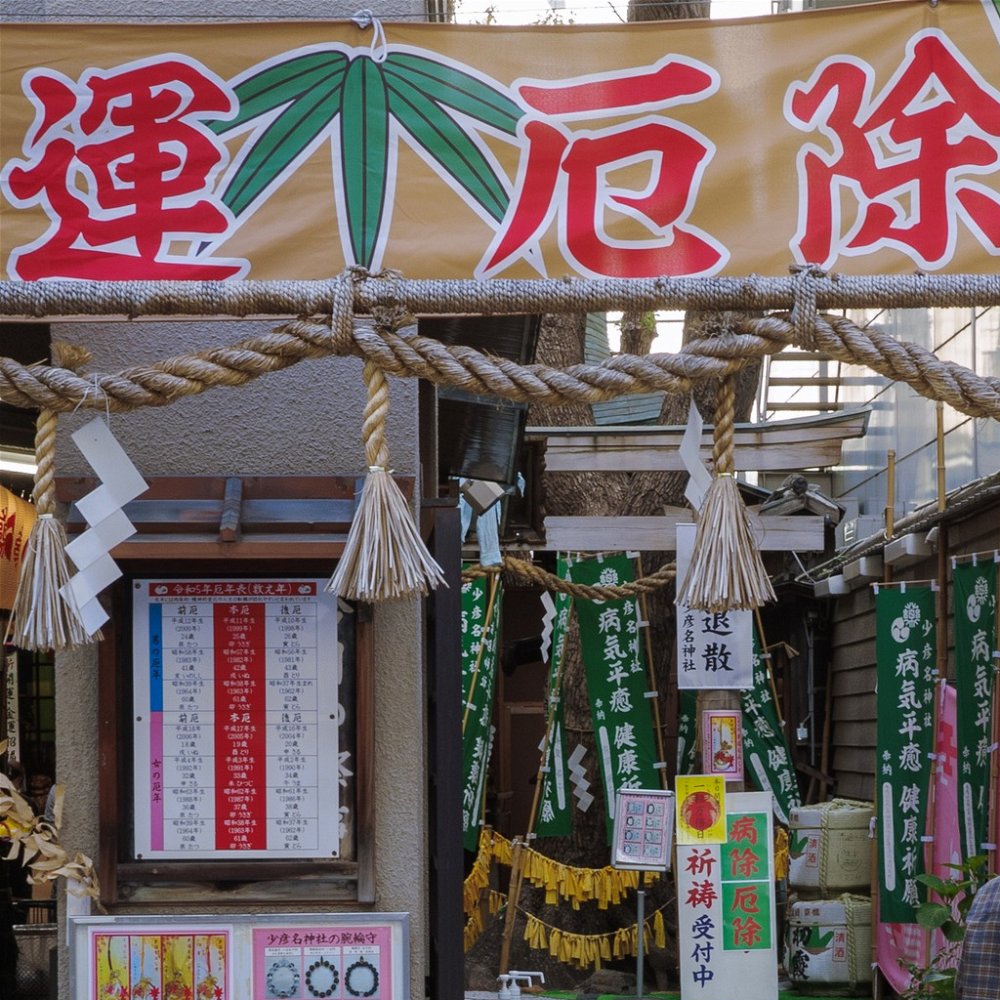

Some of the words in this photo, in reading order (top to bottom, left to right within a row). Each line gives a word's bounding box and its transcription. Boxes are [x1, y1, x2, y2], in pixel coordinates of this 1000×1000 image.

[6, 56, 248, 281] 運
[598, 608, 633, 714] 病気平癒
[622, 600, 643, 673] 彦名神社
[895, 648, 923, 773] 病気平癒
[729, 815, 761, 878] 病除
[730, 885, 763, 947] 厄除
